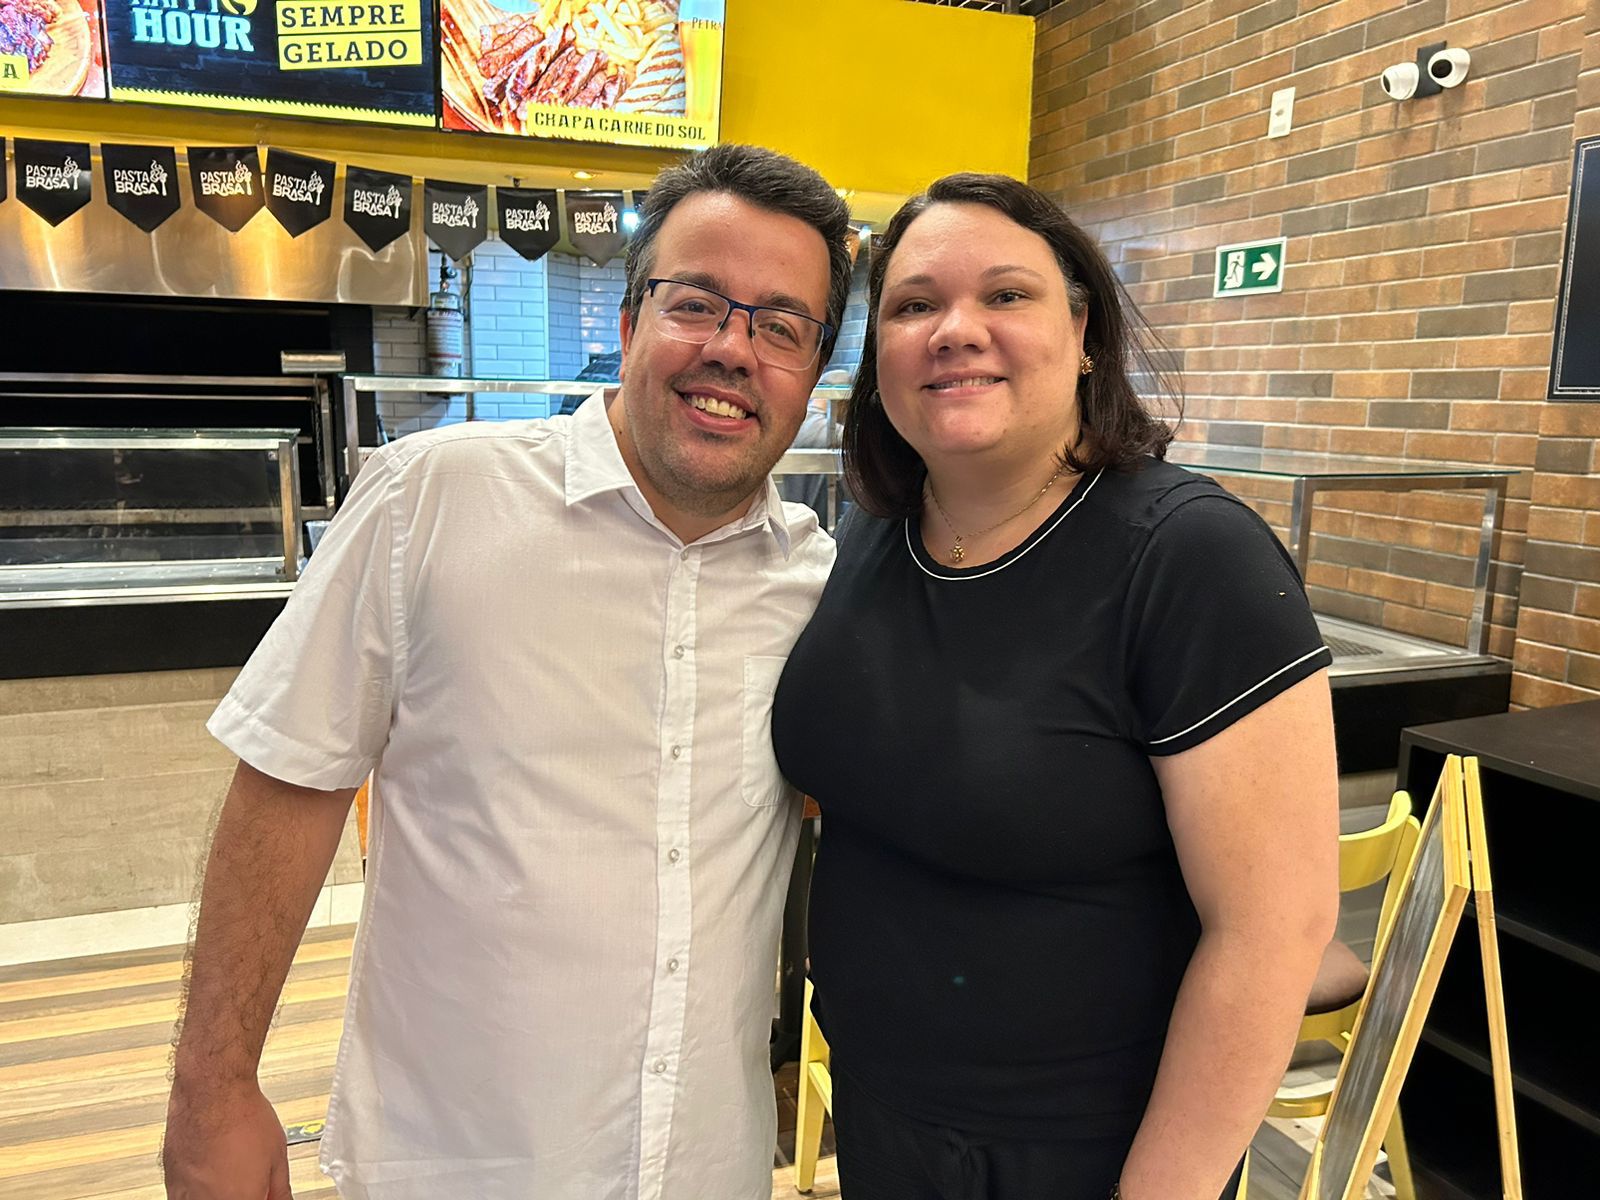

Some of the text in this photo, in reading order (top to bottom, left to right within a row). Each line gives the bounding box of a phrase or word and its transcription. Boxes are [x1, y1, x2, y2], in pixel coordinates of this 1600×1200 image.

[281, 4, 405, 28] SEMPRE
[131, 7, 255, 52] HOUR
[283, 39, 408, 64] GELADO
[534, 111, 706, 141] CHAPA CARNE DO SOL
[26, 164, 62, 178] PASTA
[114, 169, 150, 183] PASTA
[200, 171, 236, 184] PASTA
[26, 177, 70, 190] BRASA
[115, 181, 159, 196] BRASA
[274, 173, 307, 191] PASTA
[202, 183, 245, 197] BRASA
[272, 185, 314, 203] BRASA
[354, 189, 386, 206] PASTA
[353, 200, 392, 217] BRASA
[432, 202, 463, 216] PASTA
[505, 208, 536, 220] PASTA
[432, 213, 470, 227] BRASA
[574, 212, 604, 223] PASTA
[506, 219, 543, 231] BRASA
[575, 222, 611, 235] BRASA
